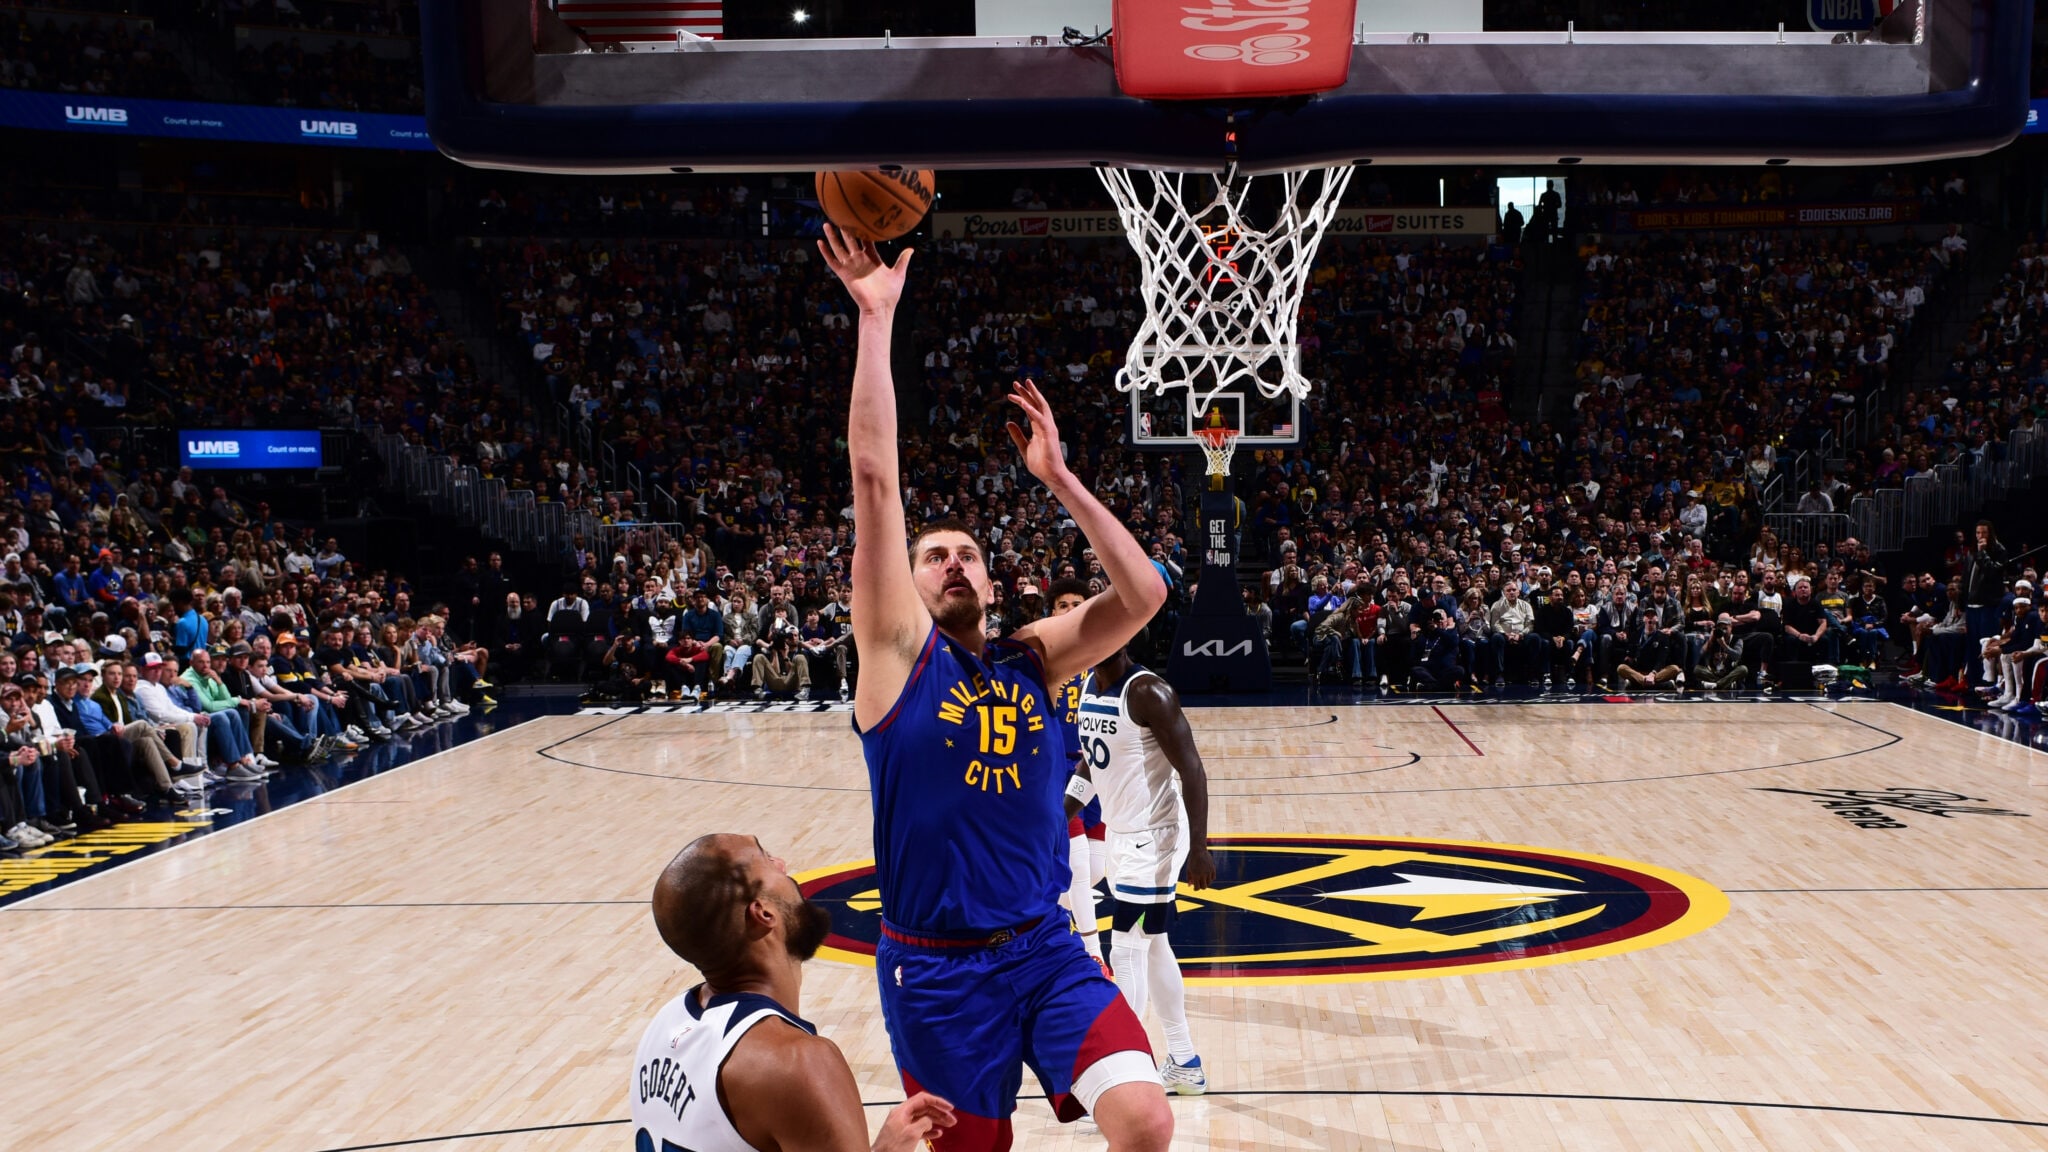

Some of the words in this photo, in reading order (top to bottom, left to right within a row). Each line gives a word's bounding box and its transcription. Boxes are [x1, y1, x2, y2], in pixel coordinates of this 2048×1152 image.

[65, 105, 128, 122] UMB
[163, 117, 188, 126] Count
[201, 120, 224, 128] more.
[300, 119, 357, 135] UMB
[390, 129, 412, 138] Count
[880, 169, 932, 208] ilson
[964, 214, 1020, 235] Coors
[1051, 217, 1119, 232] SUITES
[1311, 217, 1364, 234] oors
[1396, 215, 1464, 230] SUITES
[1637, 214, 1679, 227] EDDIE'S
[1683, 213, 1710, 224] KIDS
[1713, 209, 1786, 224] FOUNDATION
[1799, 206, 1893, 222] EDDIESKIDS.ORG
[188, 441, 240, 455] UMB
[1209, 519, 1225, 534] GET
[1209, 534, 1226, 549] THE
[1213, 550, 1231, 567] App
[938, 672, 991, 726] MILE
[990, 679, 1045, 732] HIGH
[976, 705, 1018, 755] 15
[1080, 735, 1111, 770] 30
[964, 760, 1022, 794] CITY
[1811, 799, 1909, 829] Arena
[639, 1057, 696, 1122] GOBERT
